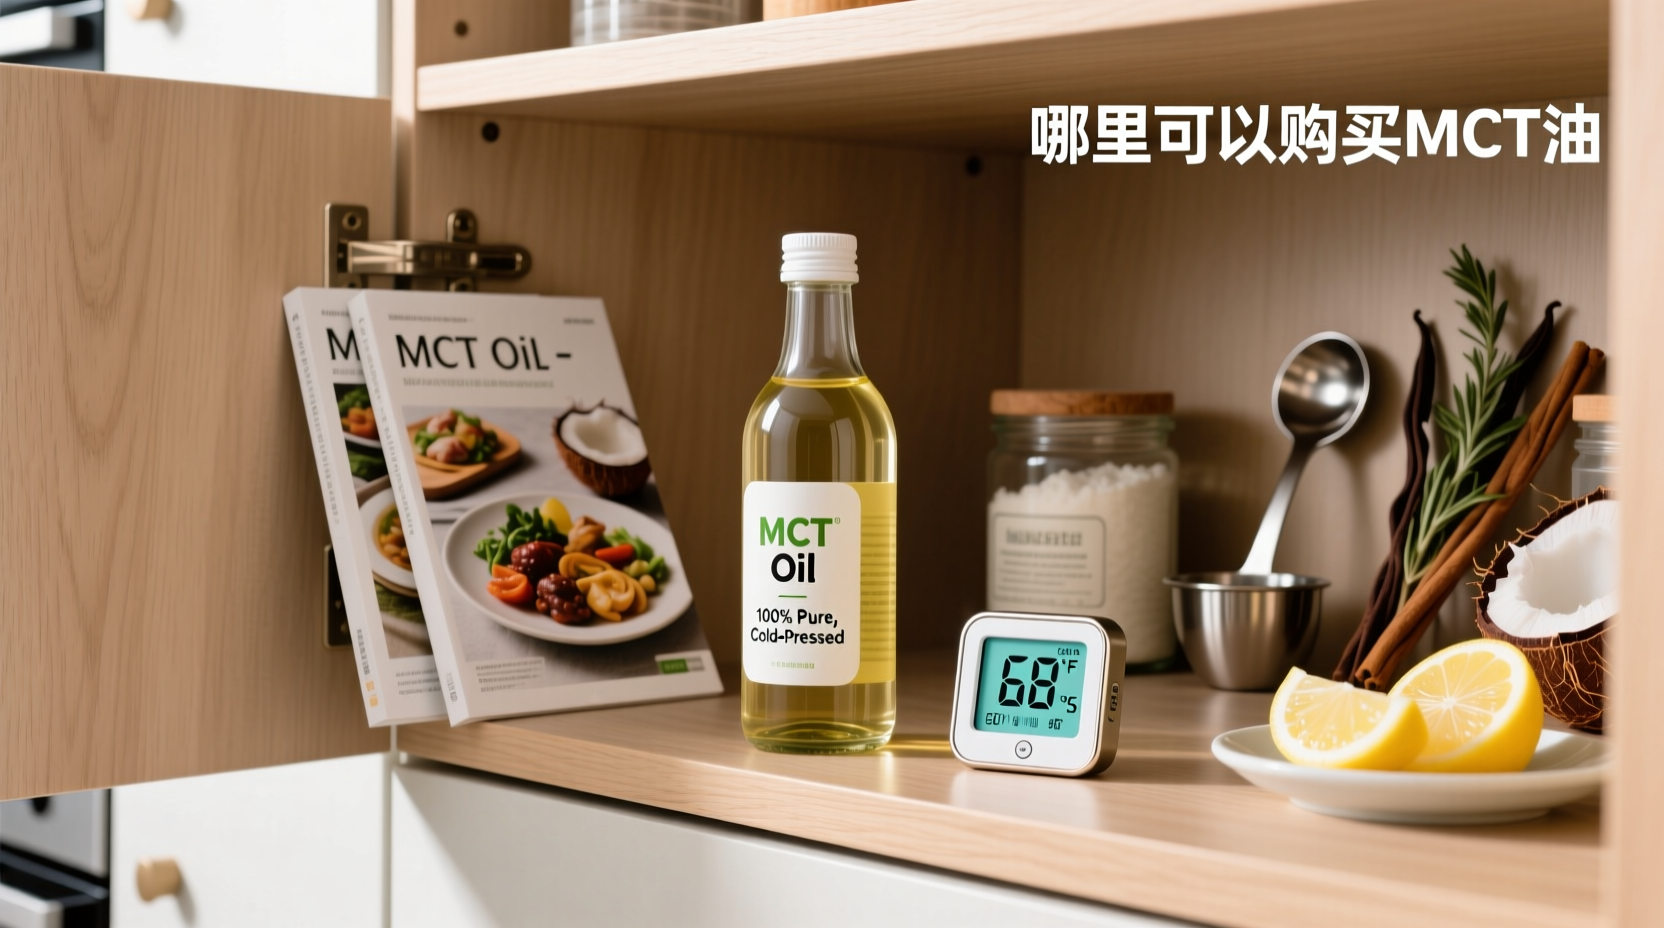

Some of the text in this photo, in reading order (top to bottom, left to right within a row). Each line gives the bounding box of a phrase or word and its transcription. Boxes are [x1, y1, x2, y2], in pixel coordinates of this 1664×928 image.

[395, 334, 478, 369] MCT
[771, 552, 816, 583] Oil
[756, 608, 838, 628] 100% Pure,
[750, 627, 845, 644] Cold-Pressed
[998, 655, 1060, 710] 68
